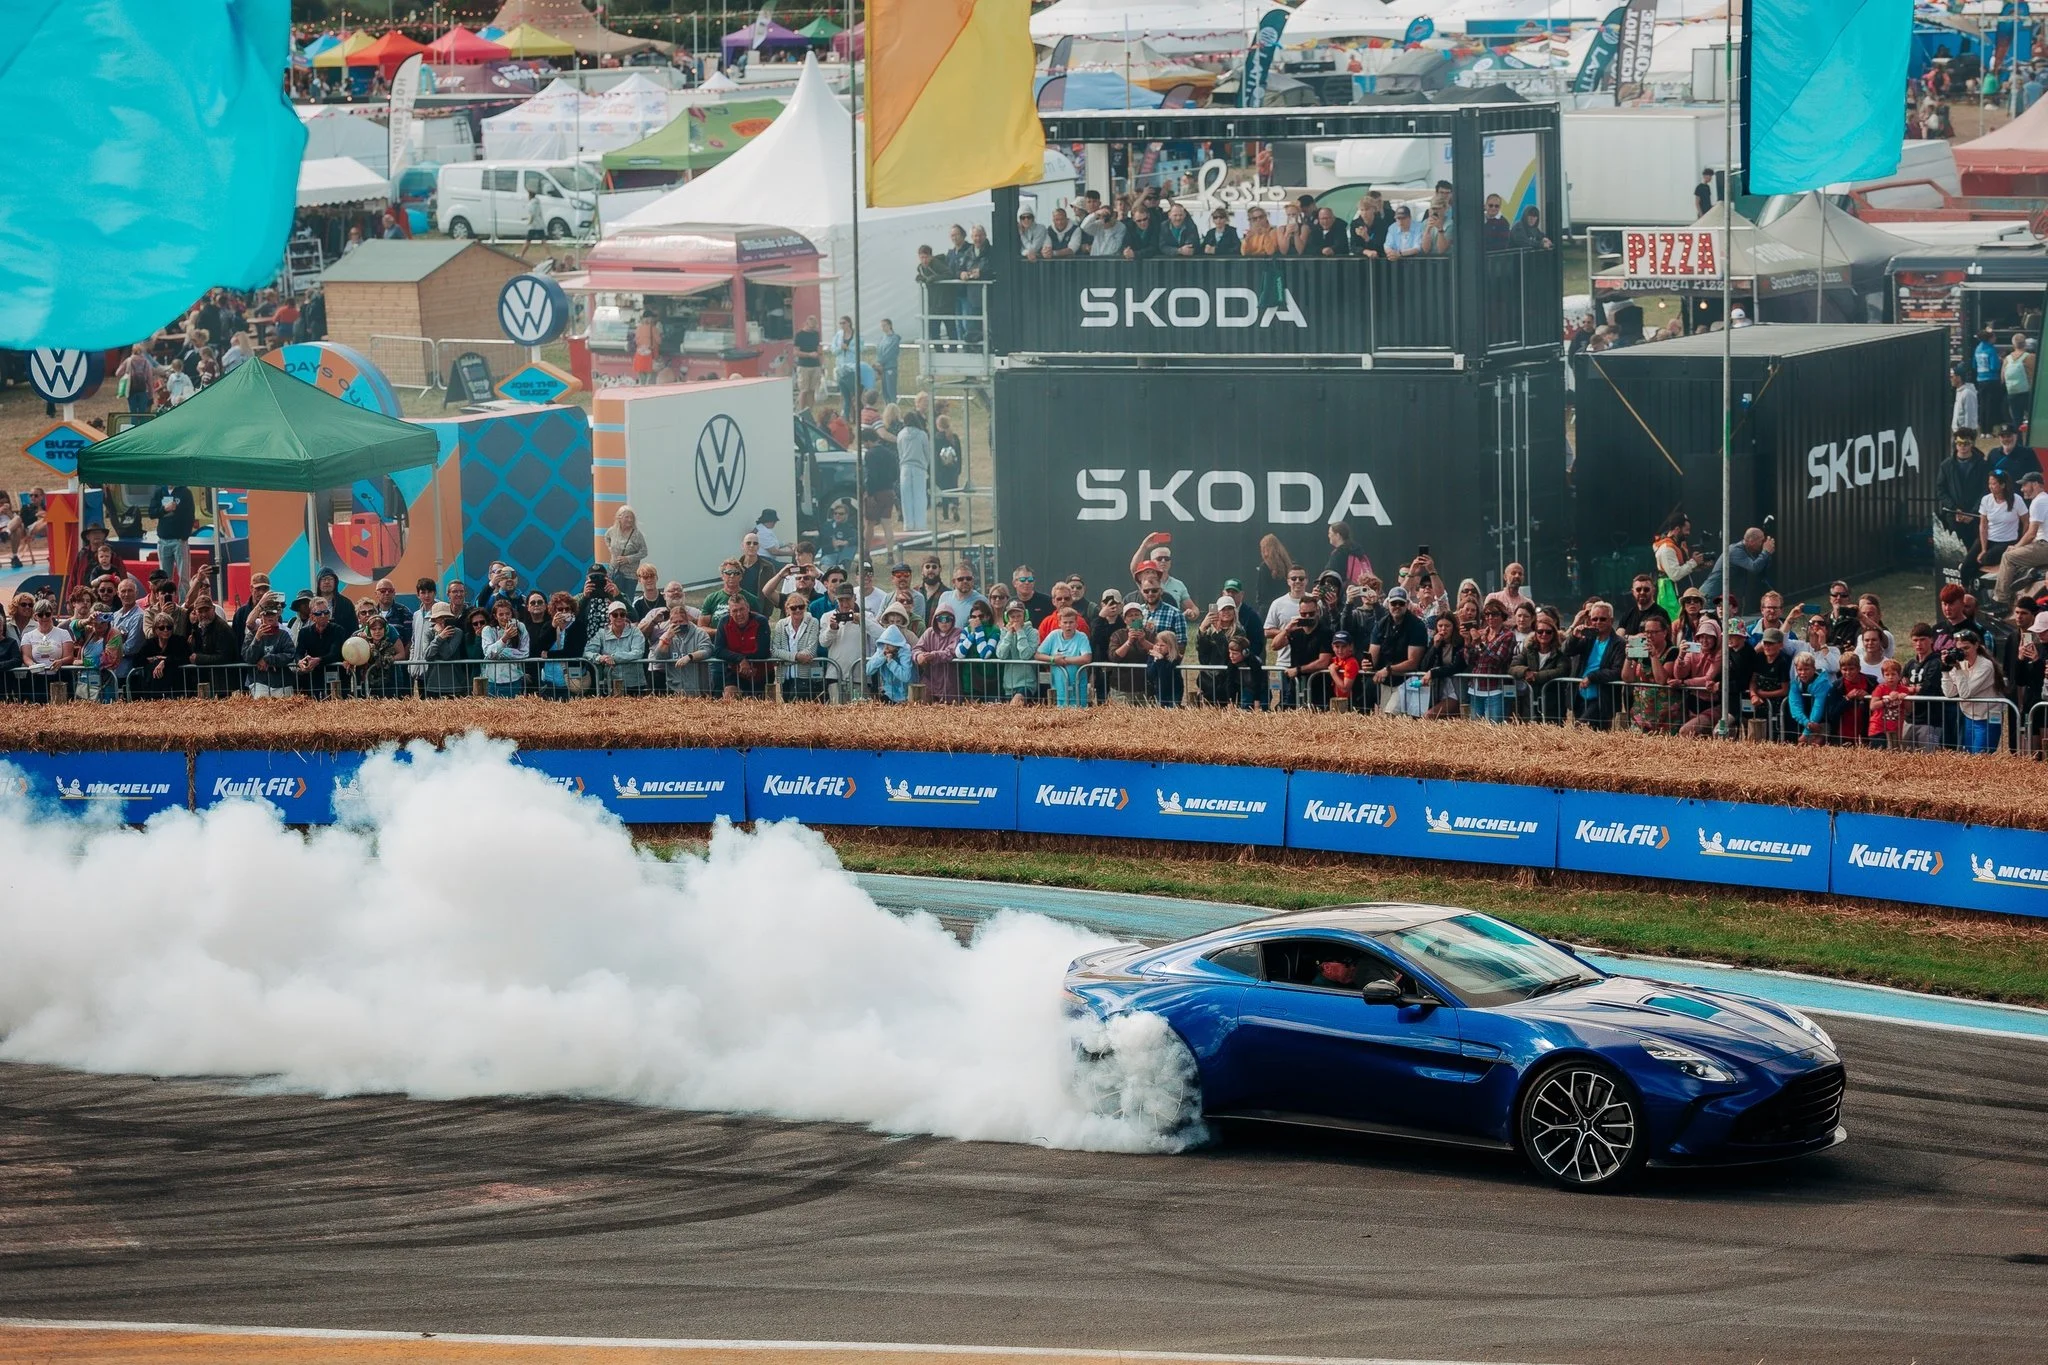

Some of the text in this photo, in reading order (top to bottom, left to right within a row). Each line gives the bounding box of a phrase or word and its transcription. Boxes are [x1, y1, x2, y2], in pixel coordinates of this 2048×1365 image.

[1620, 8, 1639, 83] ICED/HOT
[1633, 9, 1655, 83] COFFEE
[1627, 232, 1717, 275] PIZZA
[501, 279, 553, 340] VW
[1080, 287, 1308, 328] SKODA
[284, 361, 364, 409] DAYS OU
[519, 388, 550, 396] BUZZ
[536, 380, 558, 388] THE
[45, 440, 86, 449] BUZZ
[45, 451, 78, 460] STO
[695, 414, 746, 516] VW
[1808, 426, 1920, 499] SKODA
[1076, 469, 1392, 526] SKODA
[86, 783, 170, 795] MICHELIN
[642, 780, 725, 793] MICHELIN
[913, 785, 998, 798] MICHELIN
[1185, 797, 1267, 815] MICHELIN
[1453, 816, 1538, 834] MICHELIN
[1726, 838, 1812, 858] MICHELIN
